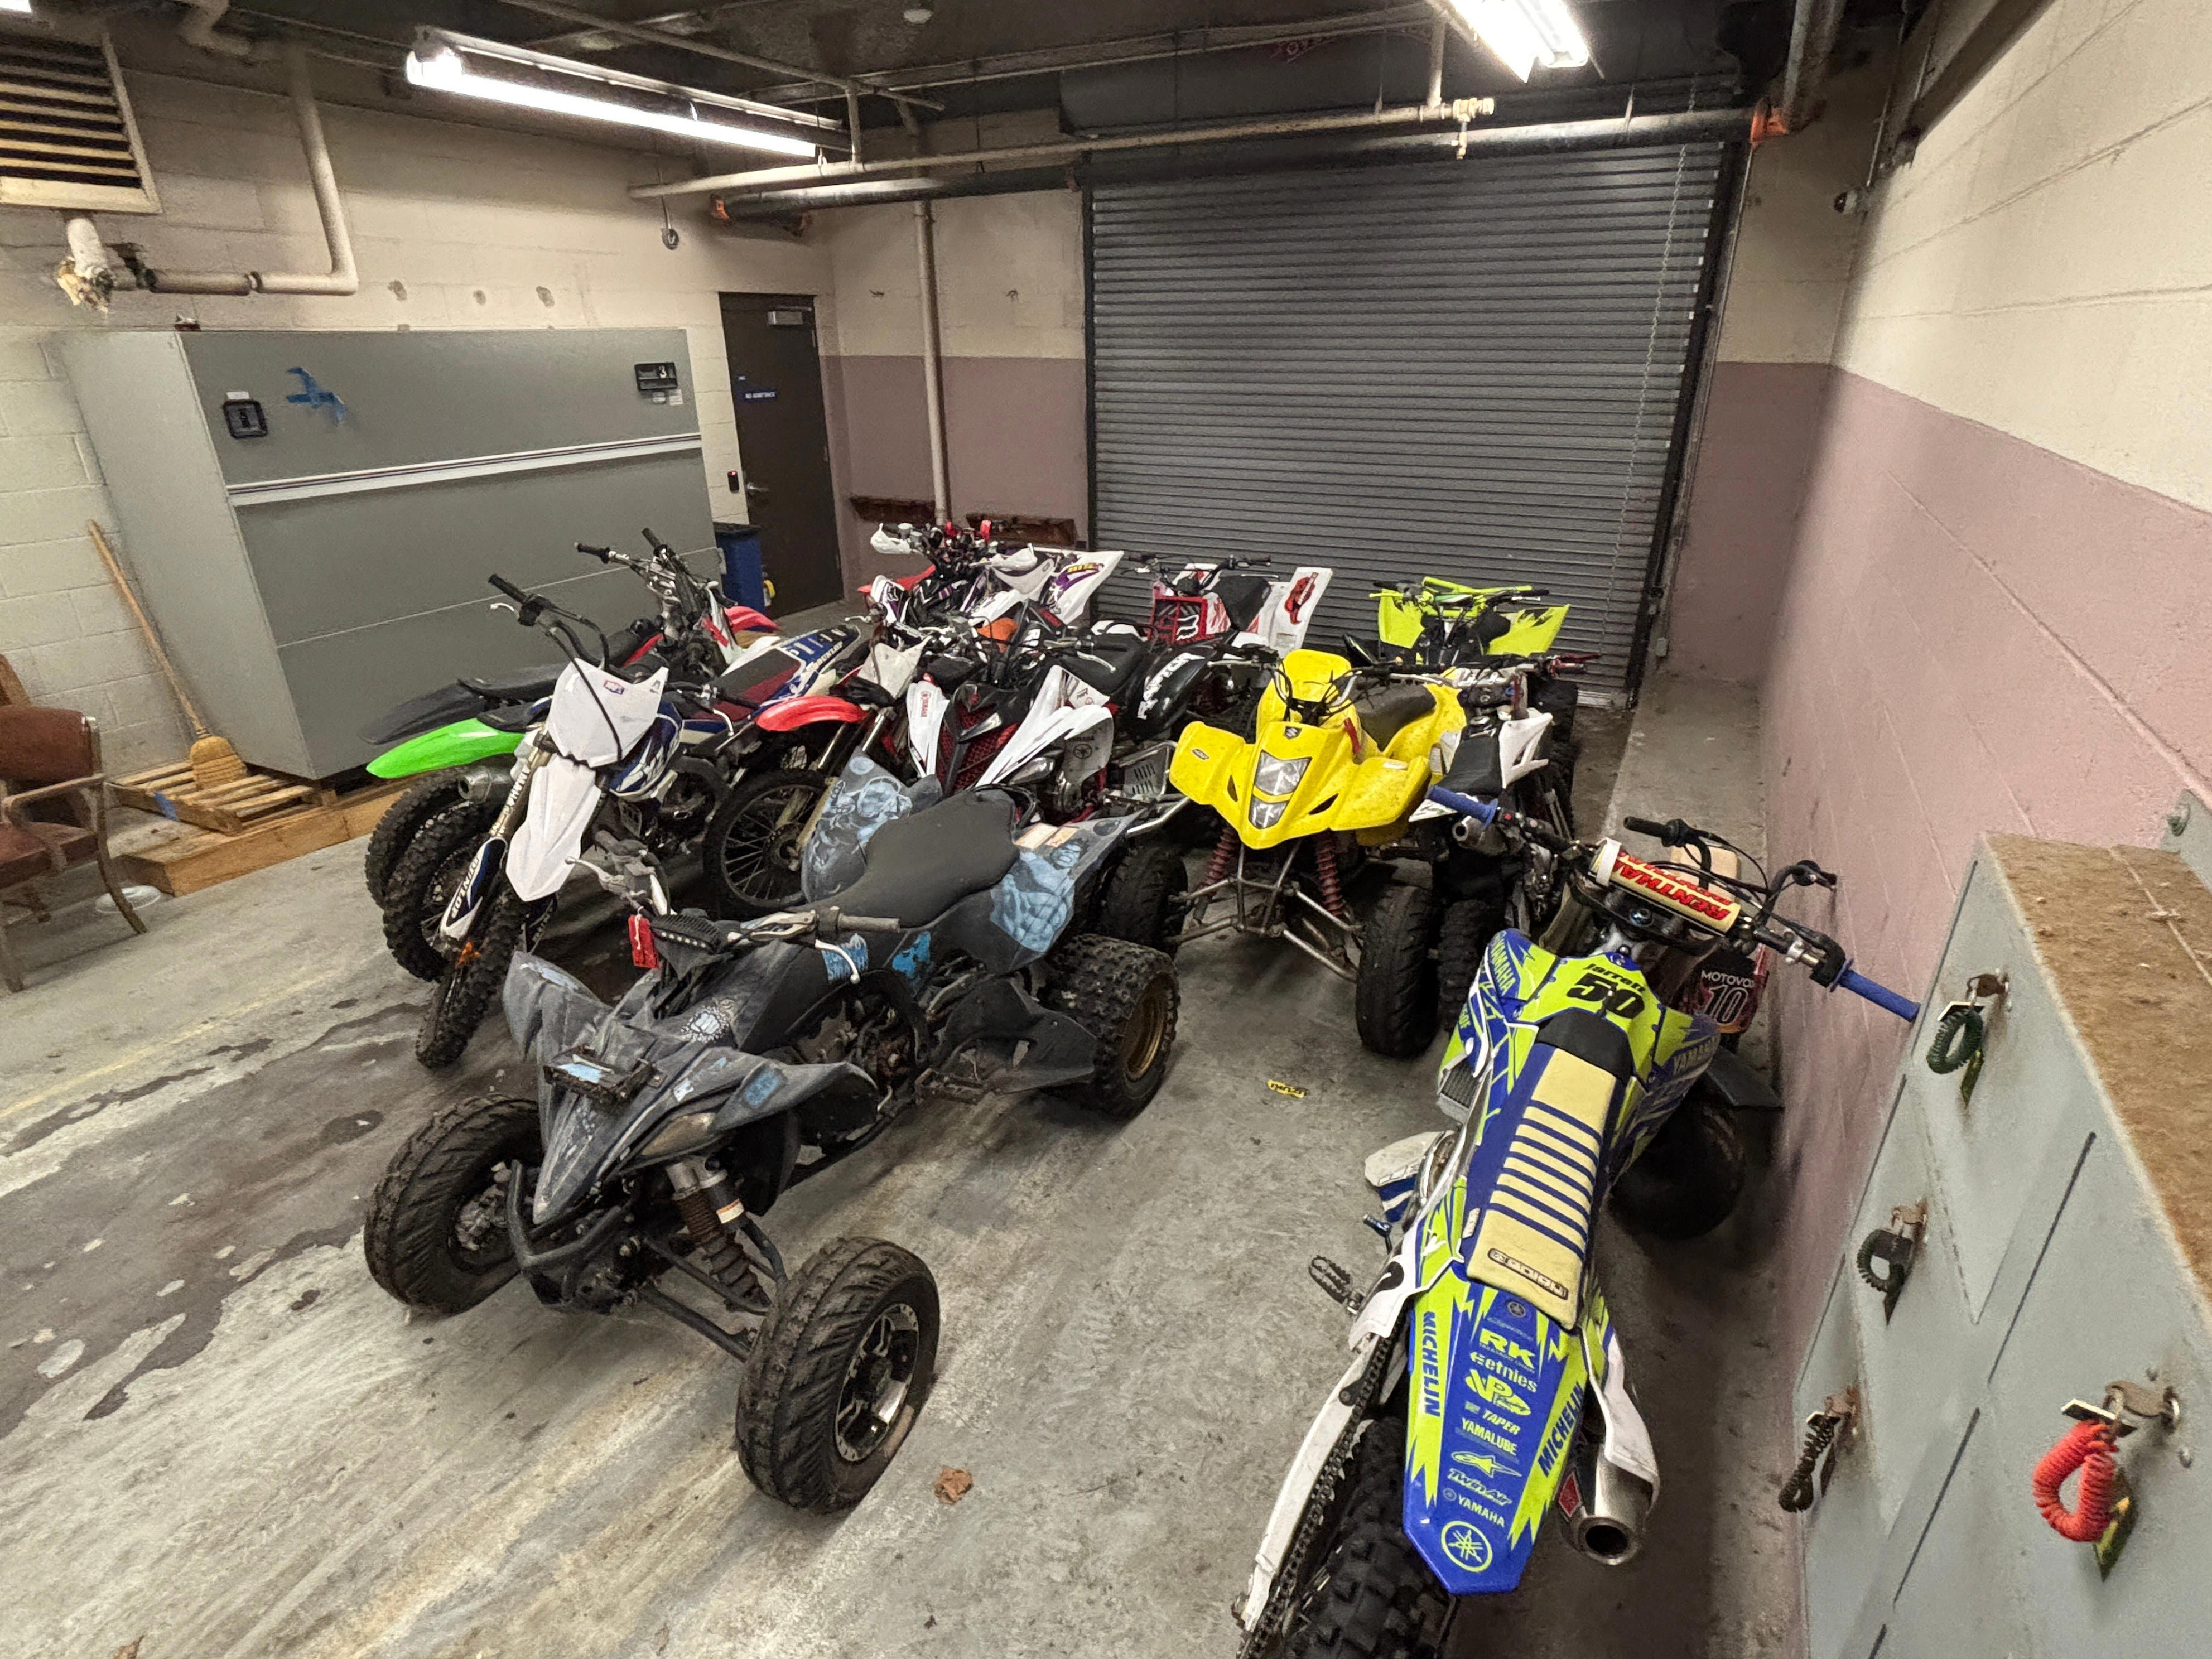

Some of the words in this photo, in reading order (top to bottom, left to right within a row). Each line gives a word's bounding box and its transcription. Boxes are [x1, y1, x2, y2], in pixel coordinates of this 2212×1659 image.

[816, 640, 844, 667] DUNLOP
[451, 856, 480, 919] DUNLOP
[1490, 938, 1516, 997] YAMAHA
[1566, 972, 1645, 1019] 50
[1703, 983, 1749, 1026] 10
[1422, 1311, 1441, 1417] MICHELIN
[1479, 1327, 1536, 1369] RK
[1485, 1358, 1538, 1393] etnies
[1462, 1417, 1518, 1456] YAMALUBE
[1482, 1409, 1521, 1435] TAPER
[1538, 1381, 1585, 1478] MICHELIN
[1458, 1494, 1505, 1528] YAMAHA
